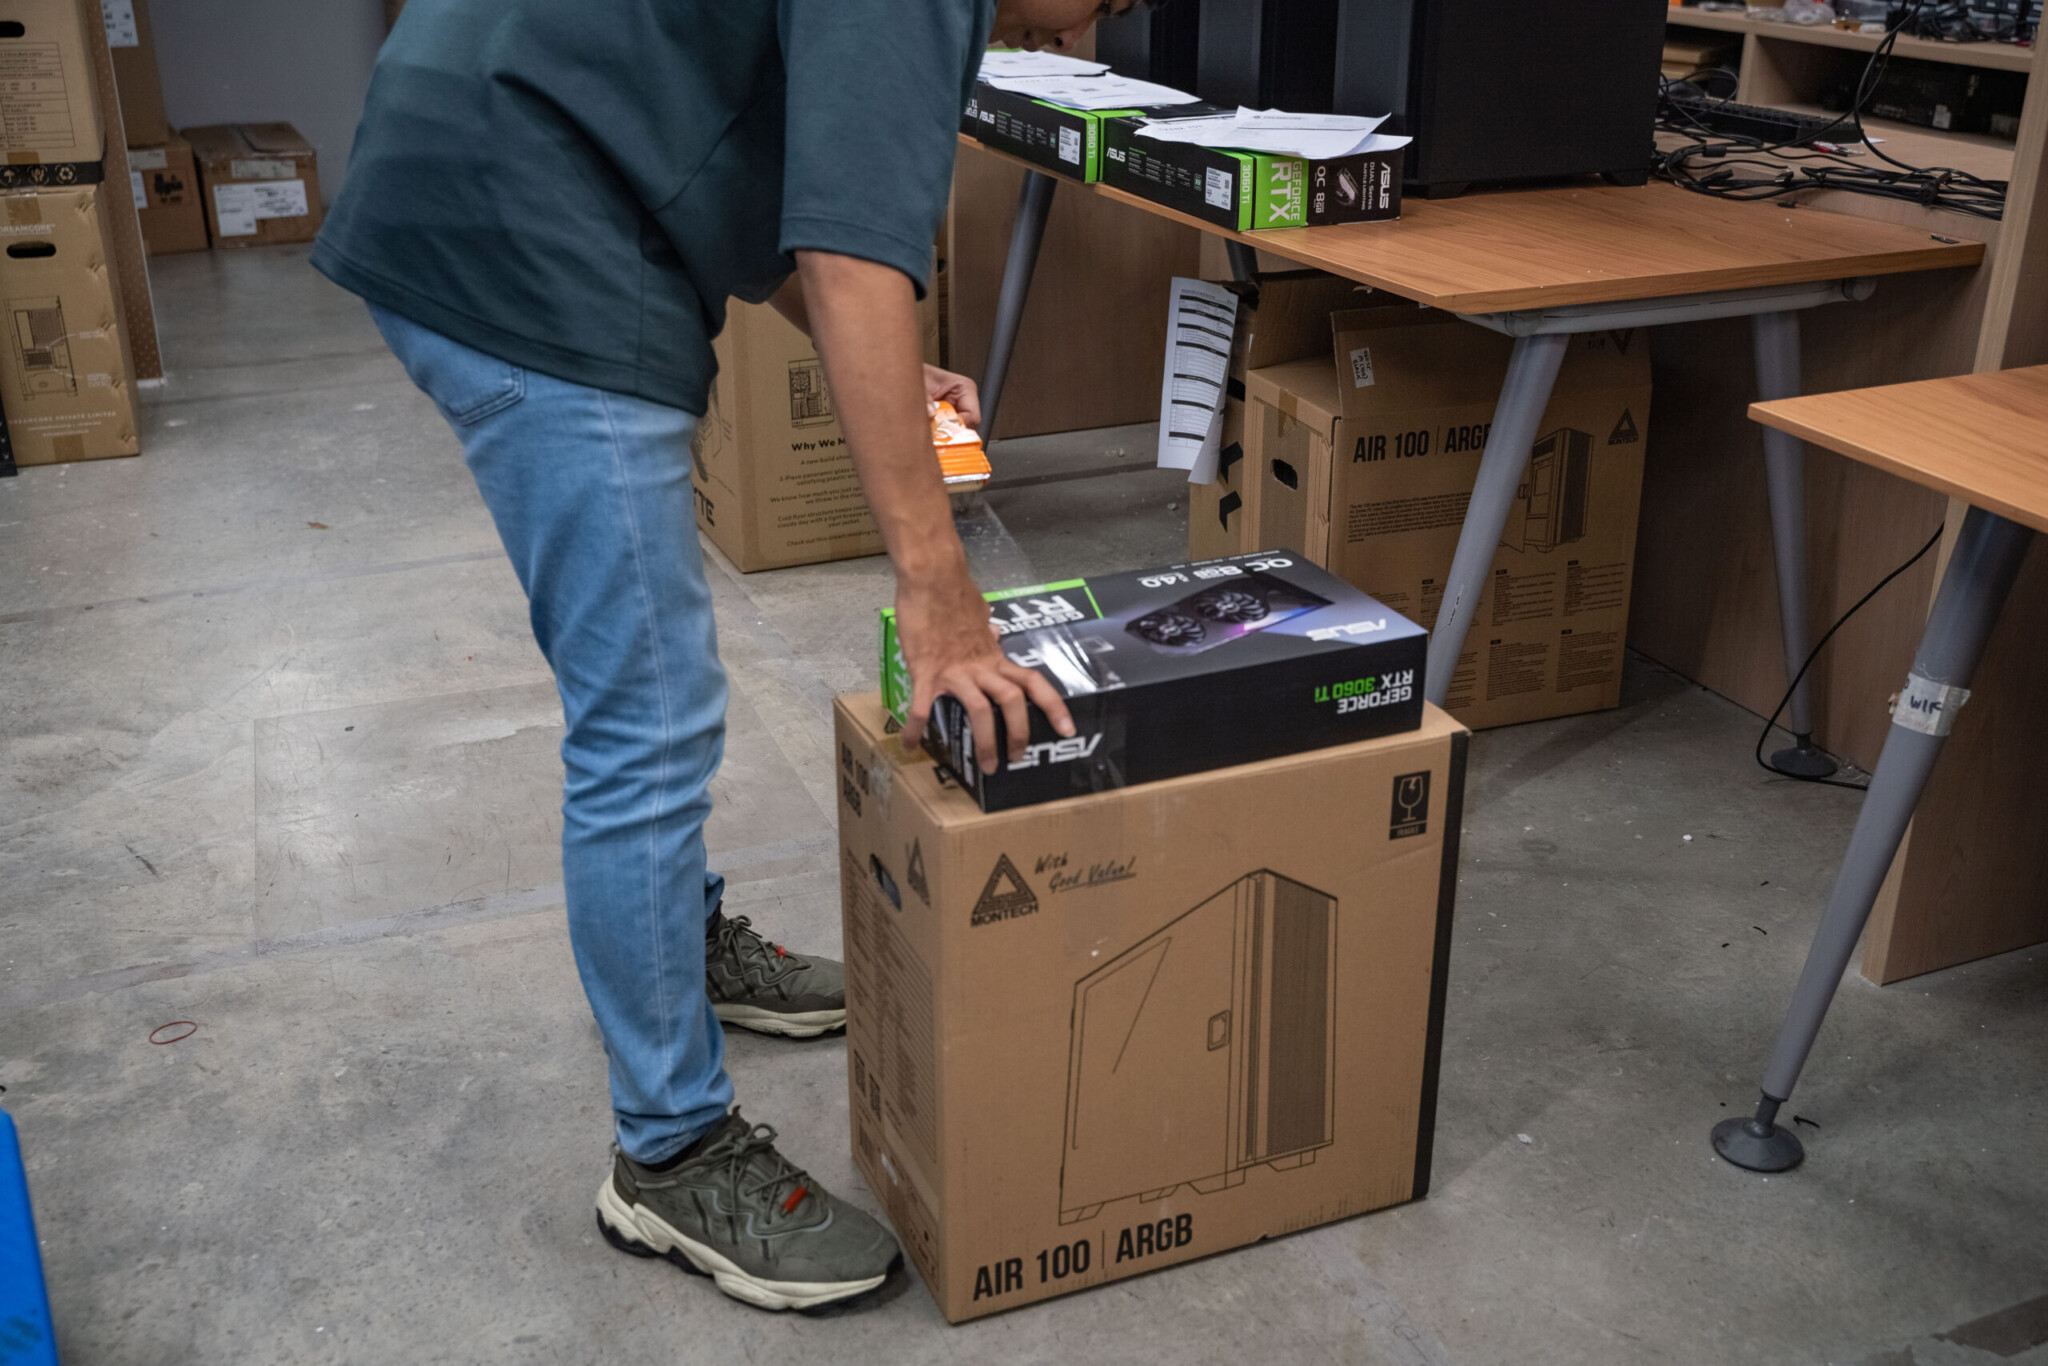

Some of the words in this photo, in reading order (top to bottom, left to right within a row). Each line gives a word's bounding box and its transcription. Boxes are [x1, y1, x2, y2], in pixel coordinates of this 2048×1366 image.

[979, 110, 995, 125] ASUS
[1087, 123, 1096, 149] 3060
[1106, 147, 1126, 163] ASUS
[1242, 164, 1251, 193] 3060
[1316, 165, 1327, 187] OC
[1379, 161, 1391, 209] ASUS
[1241, 194, 1250, 204] Ti
[1268, 162, 1292, 222] RTX
[1290, 161, 1303, 221] GEFORCE
[792, 442, 816, 452] Why
[819, 439, 836, 448] We
[1353, 434, 1386, 464] AIR
[1395, 430, 1430, 460] 100
[1244, 557, 1293, 572] OC
[999, 610, 1085, 635] GEFORC
[1305, 617, 1388, 642] ASUS
[1314, 680, 1331, 703] Ti
[1331, 675, 1376, 700] 3060
[1379, 668, 1414, 692] RTX
[1336, 685, 1412, 715] GEFORCE
[1034, 852, 1068, 874] With
[1049, 869, 1083, 894] Good
[1087, 855, 1136, 883] Value!
[971, 901, 1040, 928] MONTECH
[972, 1256, 1024, 1301] AIR
[1036, 1239, 1091, 1283] 100
[1115, 1213, 1194, 1264] ARGB
